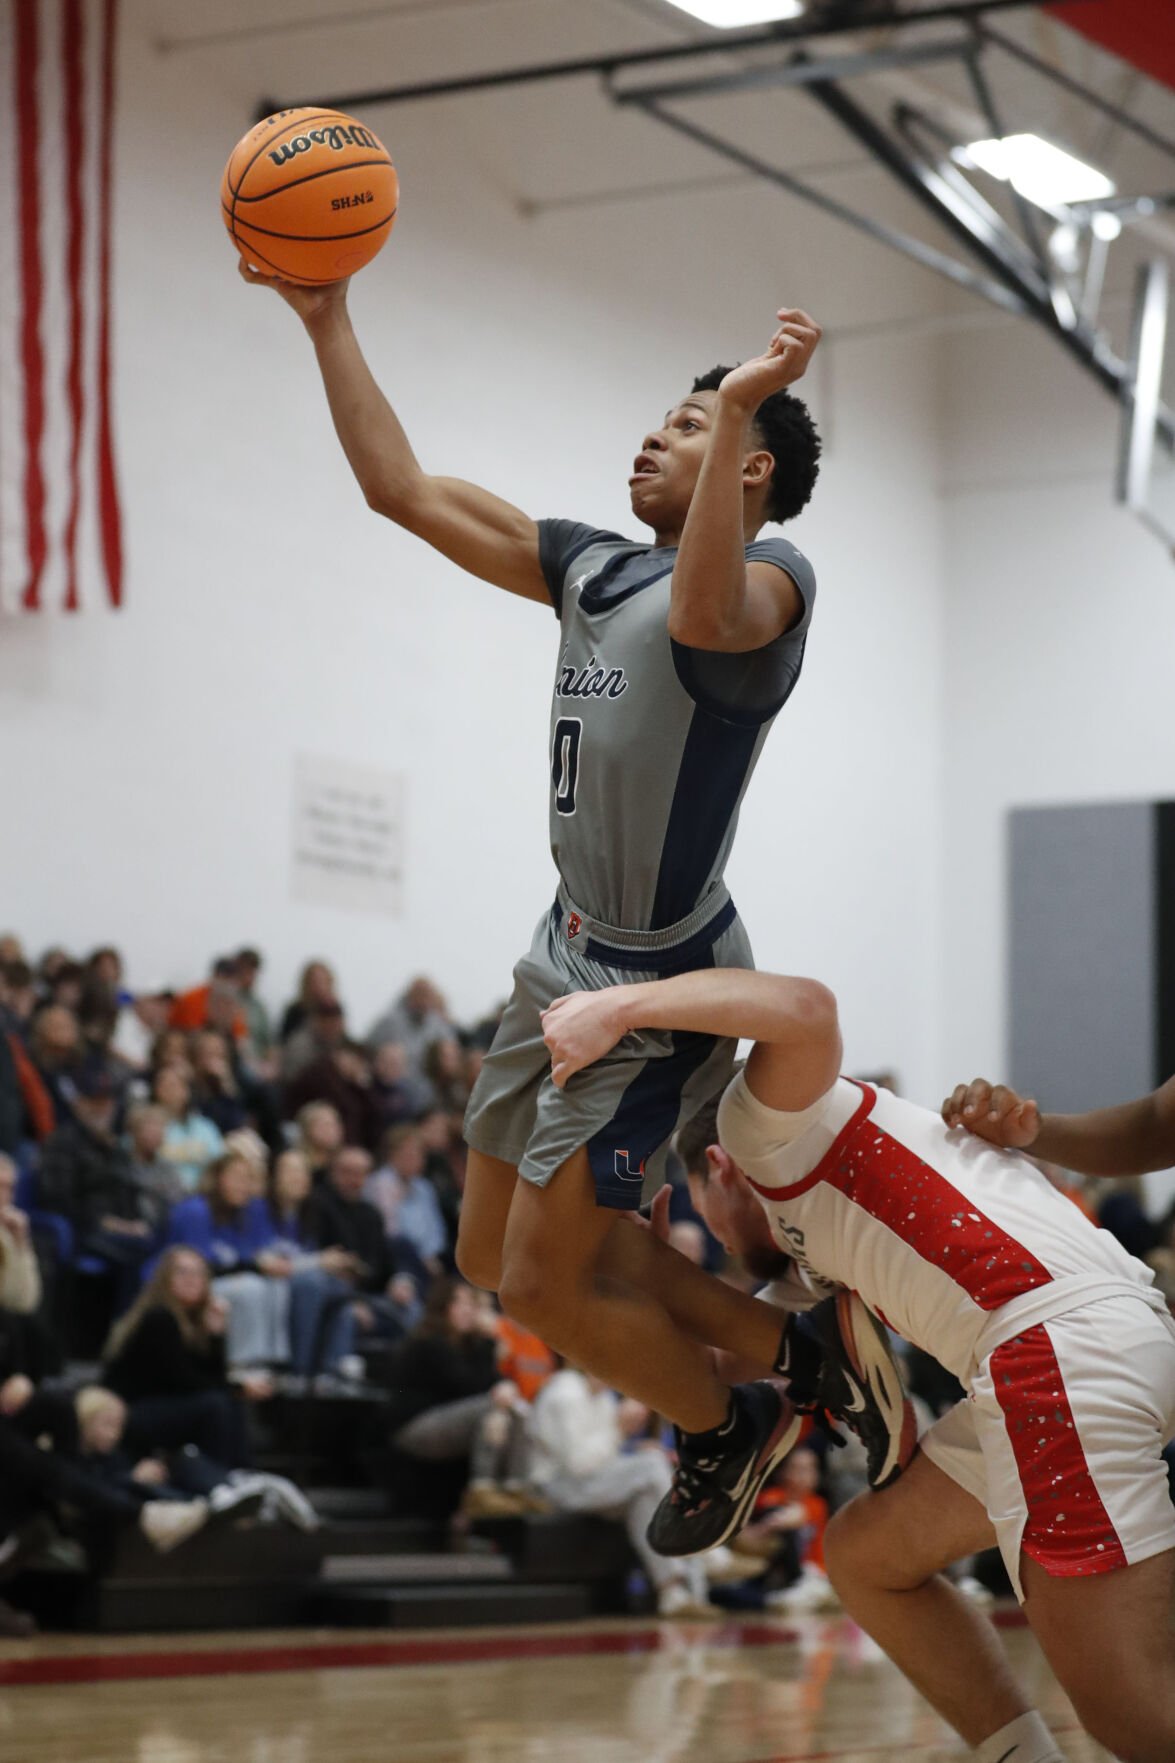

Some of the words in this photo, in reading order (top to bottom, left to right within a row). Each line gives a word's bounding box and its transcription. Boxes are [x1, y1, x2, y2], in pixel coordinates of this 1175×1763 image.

[267, 124, 381, 166] Wilson
[331, 192, 367, 211] NFHS
[555, 641, 629, 700] nion
[552, 717, 582, 816] 0
